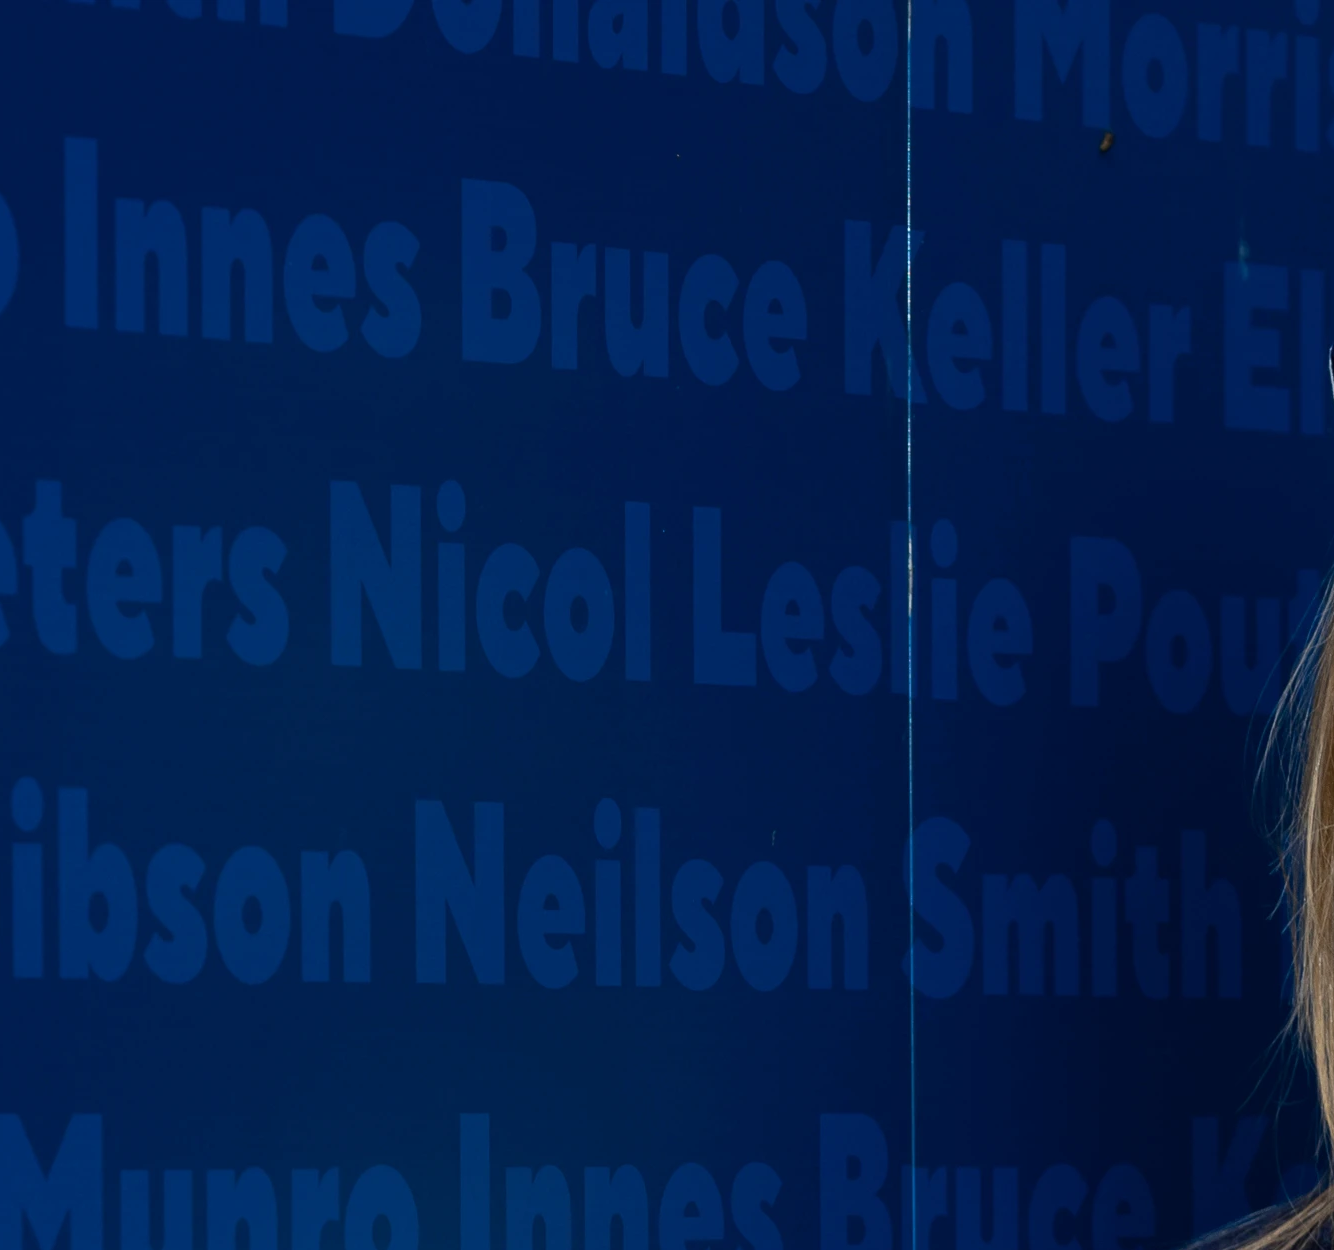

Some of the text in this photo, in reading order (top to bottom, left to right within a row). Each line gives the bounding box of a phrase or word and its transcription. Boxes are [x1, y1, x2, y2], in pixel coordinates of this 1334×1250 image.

[334, 0, 972, 112] adson
[64, 134, 419, 357] Innes
[462, 178, 809, 392] Bruce
[843, 219, 1192, 424] Keller
[330, 477, 652, 684] Nicol
[692, 505, 1034, 707] Leslie
[413, 797, 869, 992] Neilson
[901, 815, 1244, 1000] Smith
